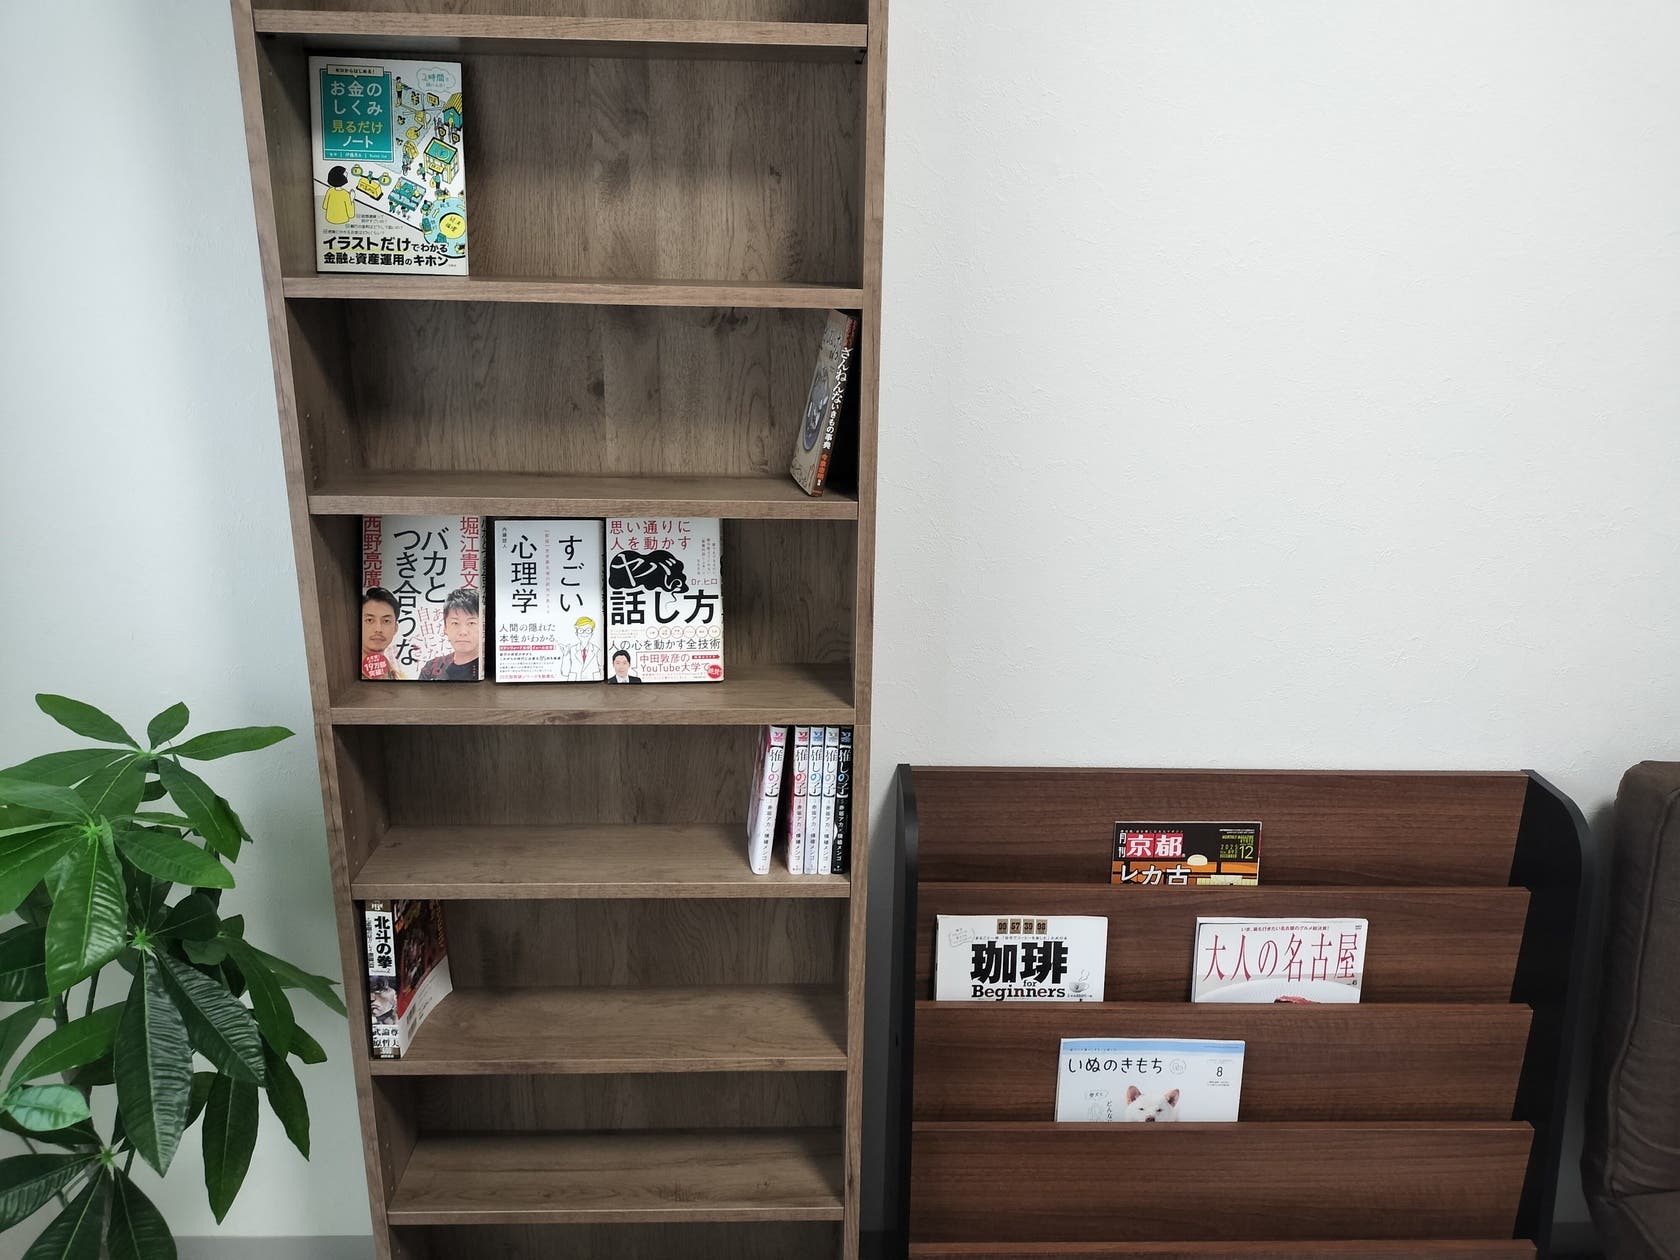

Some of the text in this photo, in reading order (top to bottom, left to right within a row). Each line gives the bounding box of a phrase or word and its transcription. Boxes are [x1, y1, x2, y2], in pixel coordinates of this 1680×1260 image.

[330, 80, 382, 97] お金の
[334, 101, 383, 116] しくみ
[331, 120, 383, 134] 見るだけ
[342, 136, 373, 148] ノート
[323, 236, 448, 253] イラストだけでわかる
[323, 251, 449, 267] 金融と資産運用のキホン
[610, 520, 691, 534] 思い通りに
[610, 536, 691, 551] 人を動かす
[363, 517, 382, 588] 西野亮廣
[460, 517, 480, 590] 堀江貴文
[421, 526, 449, 603] バカと
[511, 534, 538, 613] 心理学
[558, 535, 585, 612] すごい
[392, 529, 422, 666] つき合うな
[610, 589, 719, 625] 話し方
[499, 623, 556, 632] 人間の隠れた
[609, 639, 720, 651] 人の心を動かす全技術
[640, 654, 690, 664] 中田敦彦の
[1118, 833, 1126, 858] 月刊
[1127, 834, 1183, 857] 京都
[1239, 845, 1254, 859] 12
[374, 915, 393, 969] 北斗の拳
[971, 940, 1069, 985] 珈琲
[1203, 933, 1358, 983] 大人の名古屋
[1023, 979, 1037, 987] for
[971, 985, 1066, 1000] Beginners
[1068, 1057, 1163, 1074] いぬのきもち
[1216, 1066, 1223, 1077] 8
